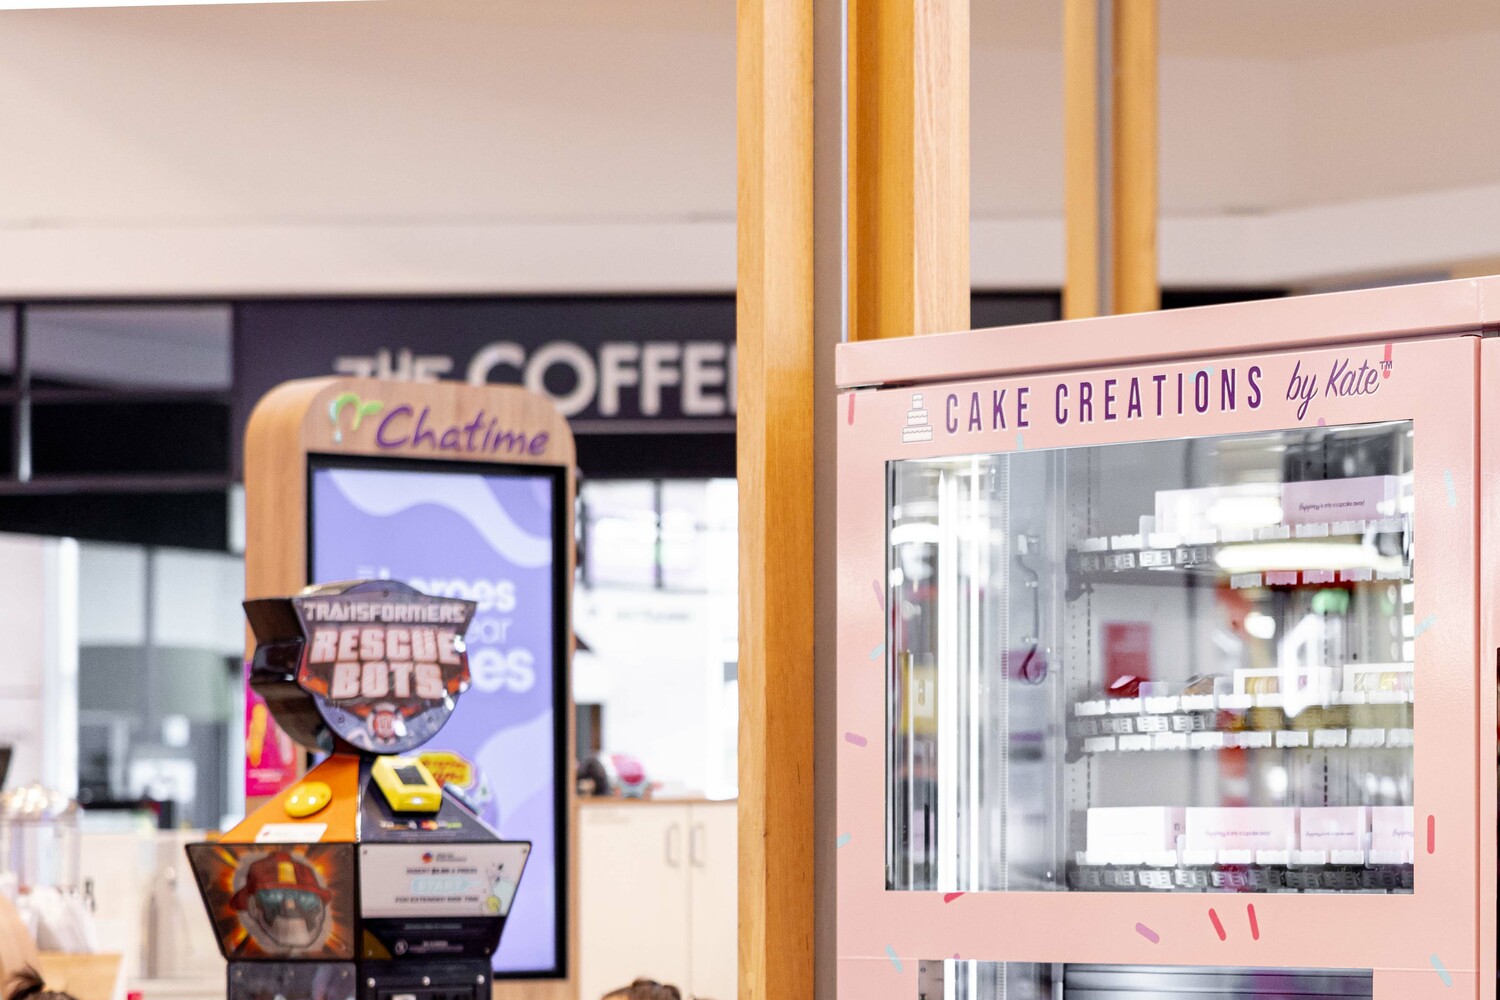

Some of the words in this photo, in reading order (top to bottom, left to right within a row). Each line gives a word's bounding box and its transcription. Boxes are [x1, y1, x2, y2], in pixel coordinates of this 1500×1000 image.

[466, 341, 737, 416] COFFE
[945, 387, 1029, 435] CAKE
[1055, 365, 1262, 426] CREATIONS
[1286, 359, 1318, 421] by
[375, 403, 550, 456] Chatime
[303, 600, 467, 624] TRANSFORMERS
[309, 627, 462, 665] RESCUE
[331, 661, 444, 700] BOTS
